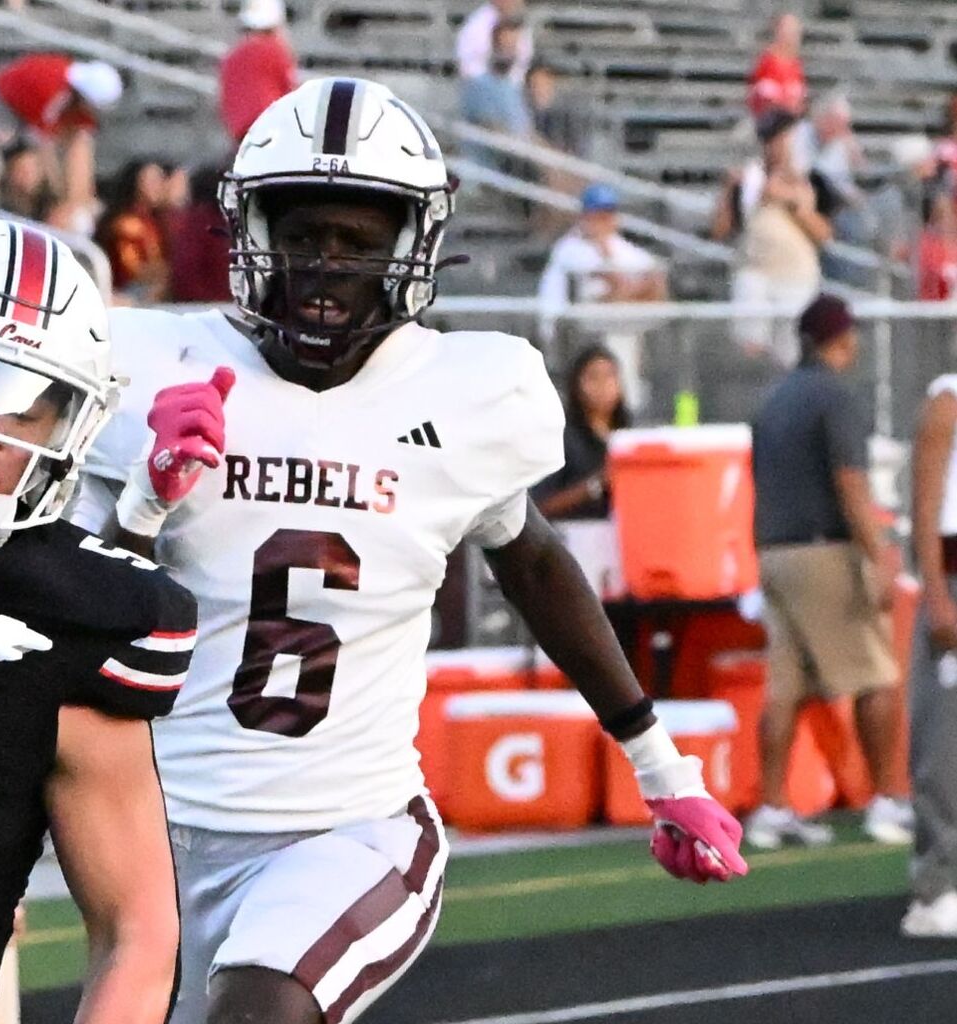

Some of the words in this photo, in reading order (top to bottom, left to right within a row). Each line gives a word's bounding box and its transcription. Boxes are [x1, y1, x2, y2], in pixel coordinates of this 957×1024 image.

[222, 454, 399, 514] REBELS
[226, 528, 360, 738] 6
[484, 732, 546, 803] G
